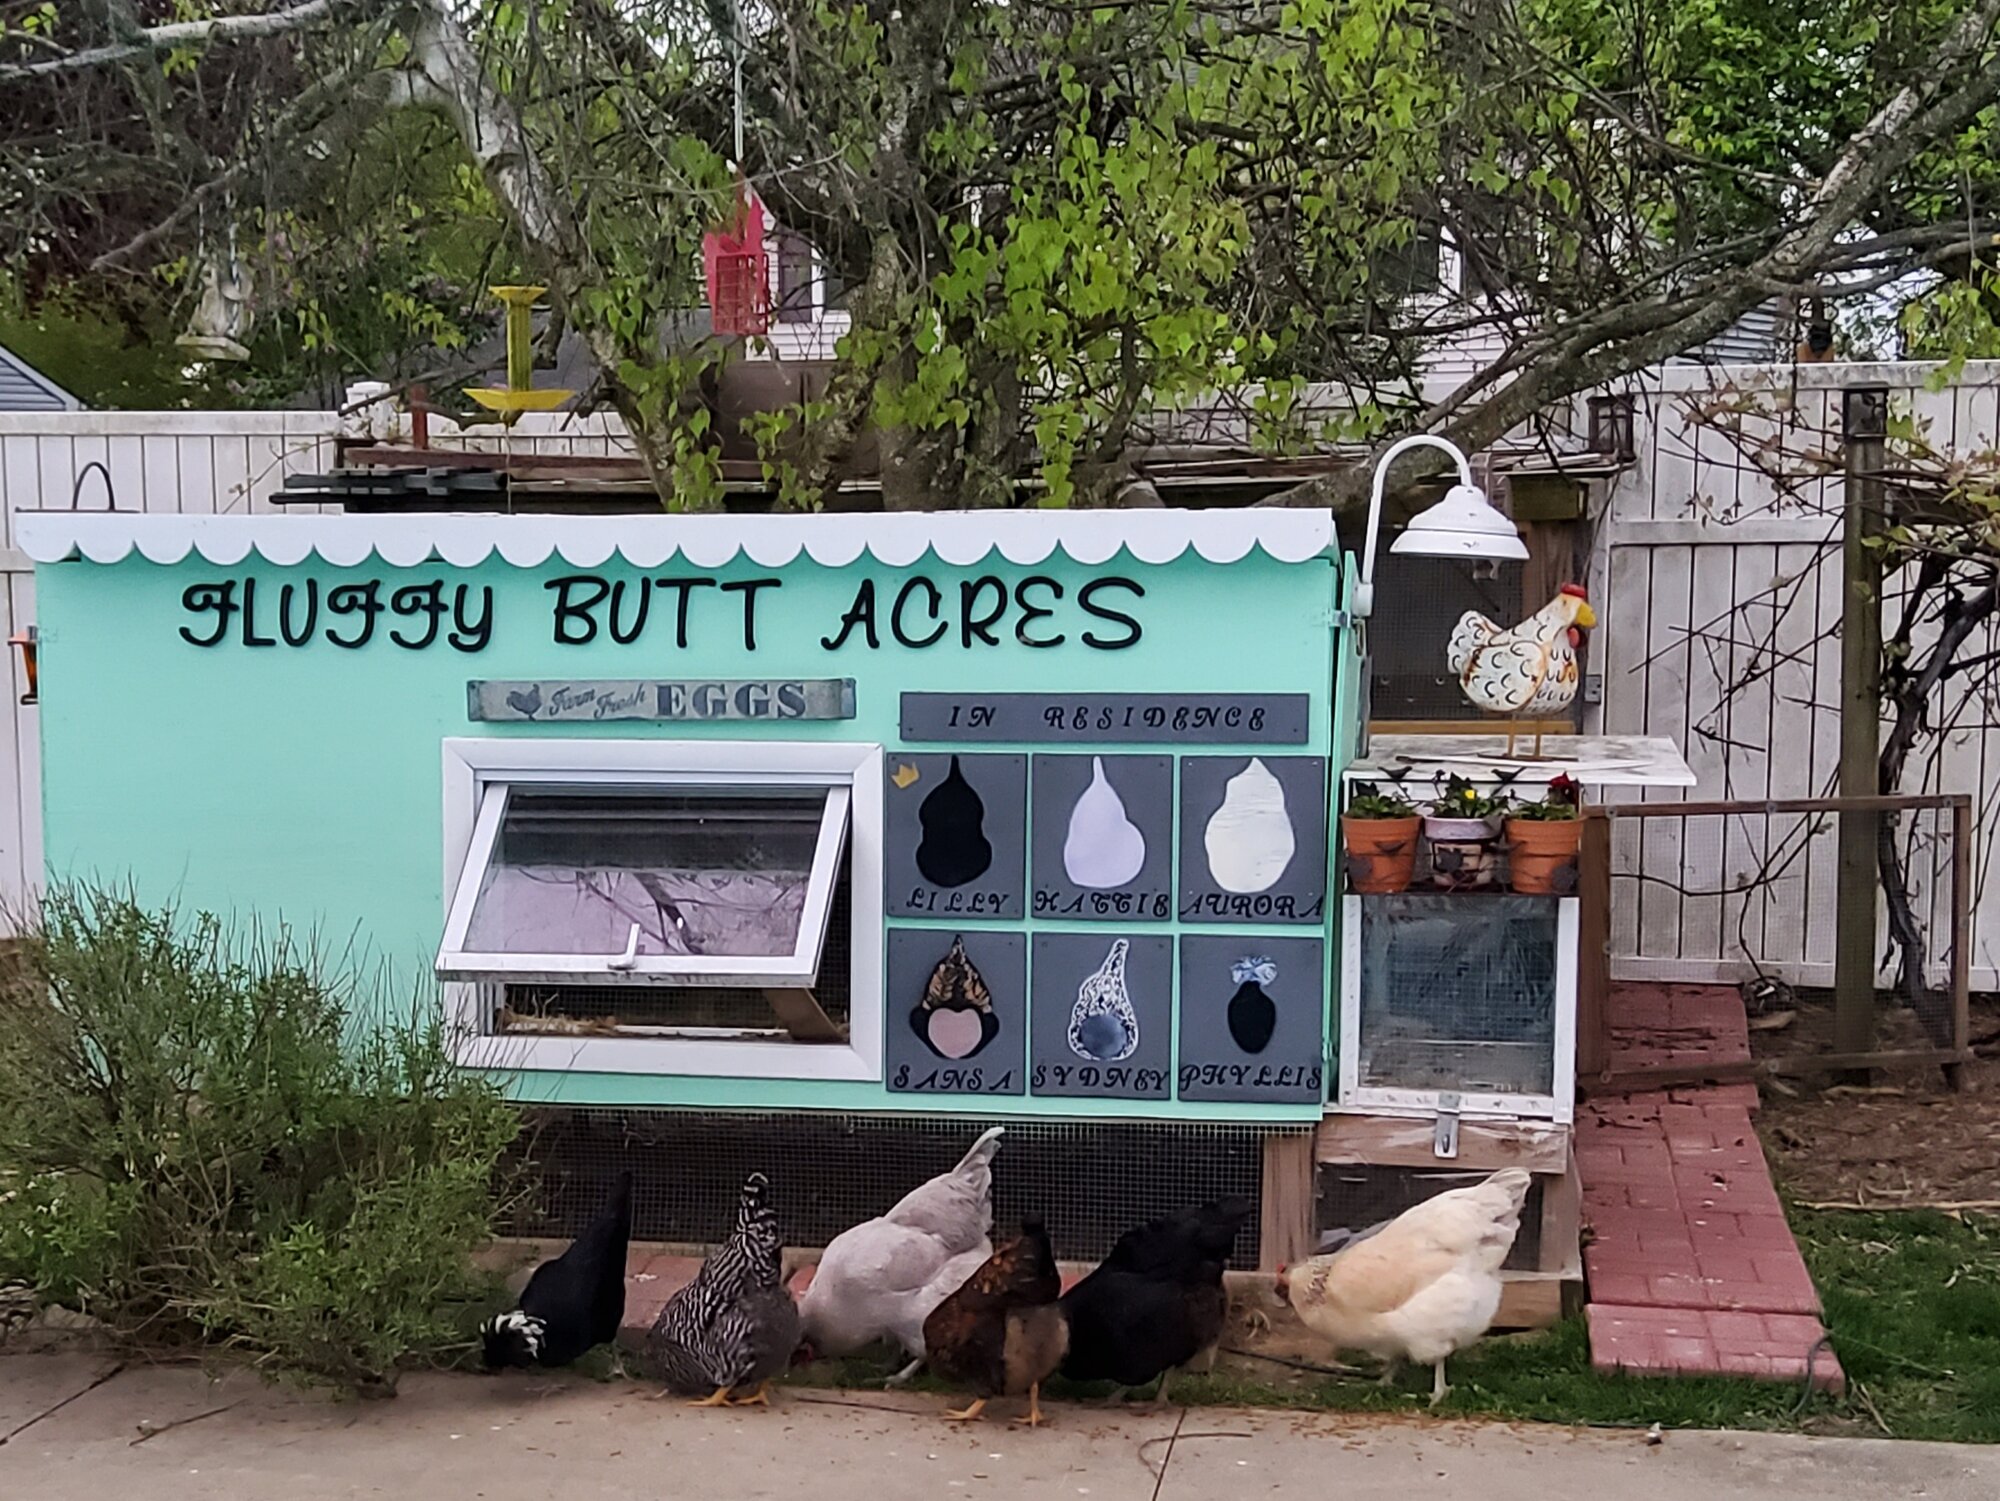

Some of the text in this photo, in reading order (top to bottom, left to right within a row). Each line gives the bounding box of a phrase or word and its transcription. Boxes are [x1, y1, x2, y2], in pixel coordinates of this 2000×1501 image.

[179, 574, 1146, 653] FLUFFY BUTT ACRES
[654, 683, 807, 719] EGGS
[948, 705, 1267, 731] IN RESIDENCE
[906, 889, 1010, 914] LILLY
[1033, 890, 1170, 918] HATTIE
[1178, 894, 1325, 918] AURORA
[893, 1067, 1016, 1091] SANSA
[1031, 1065, 1170, 1092] SYDNEY
[1178, 1064, 1323, 1092] PHYLLIS
